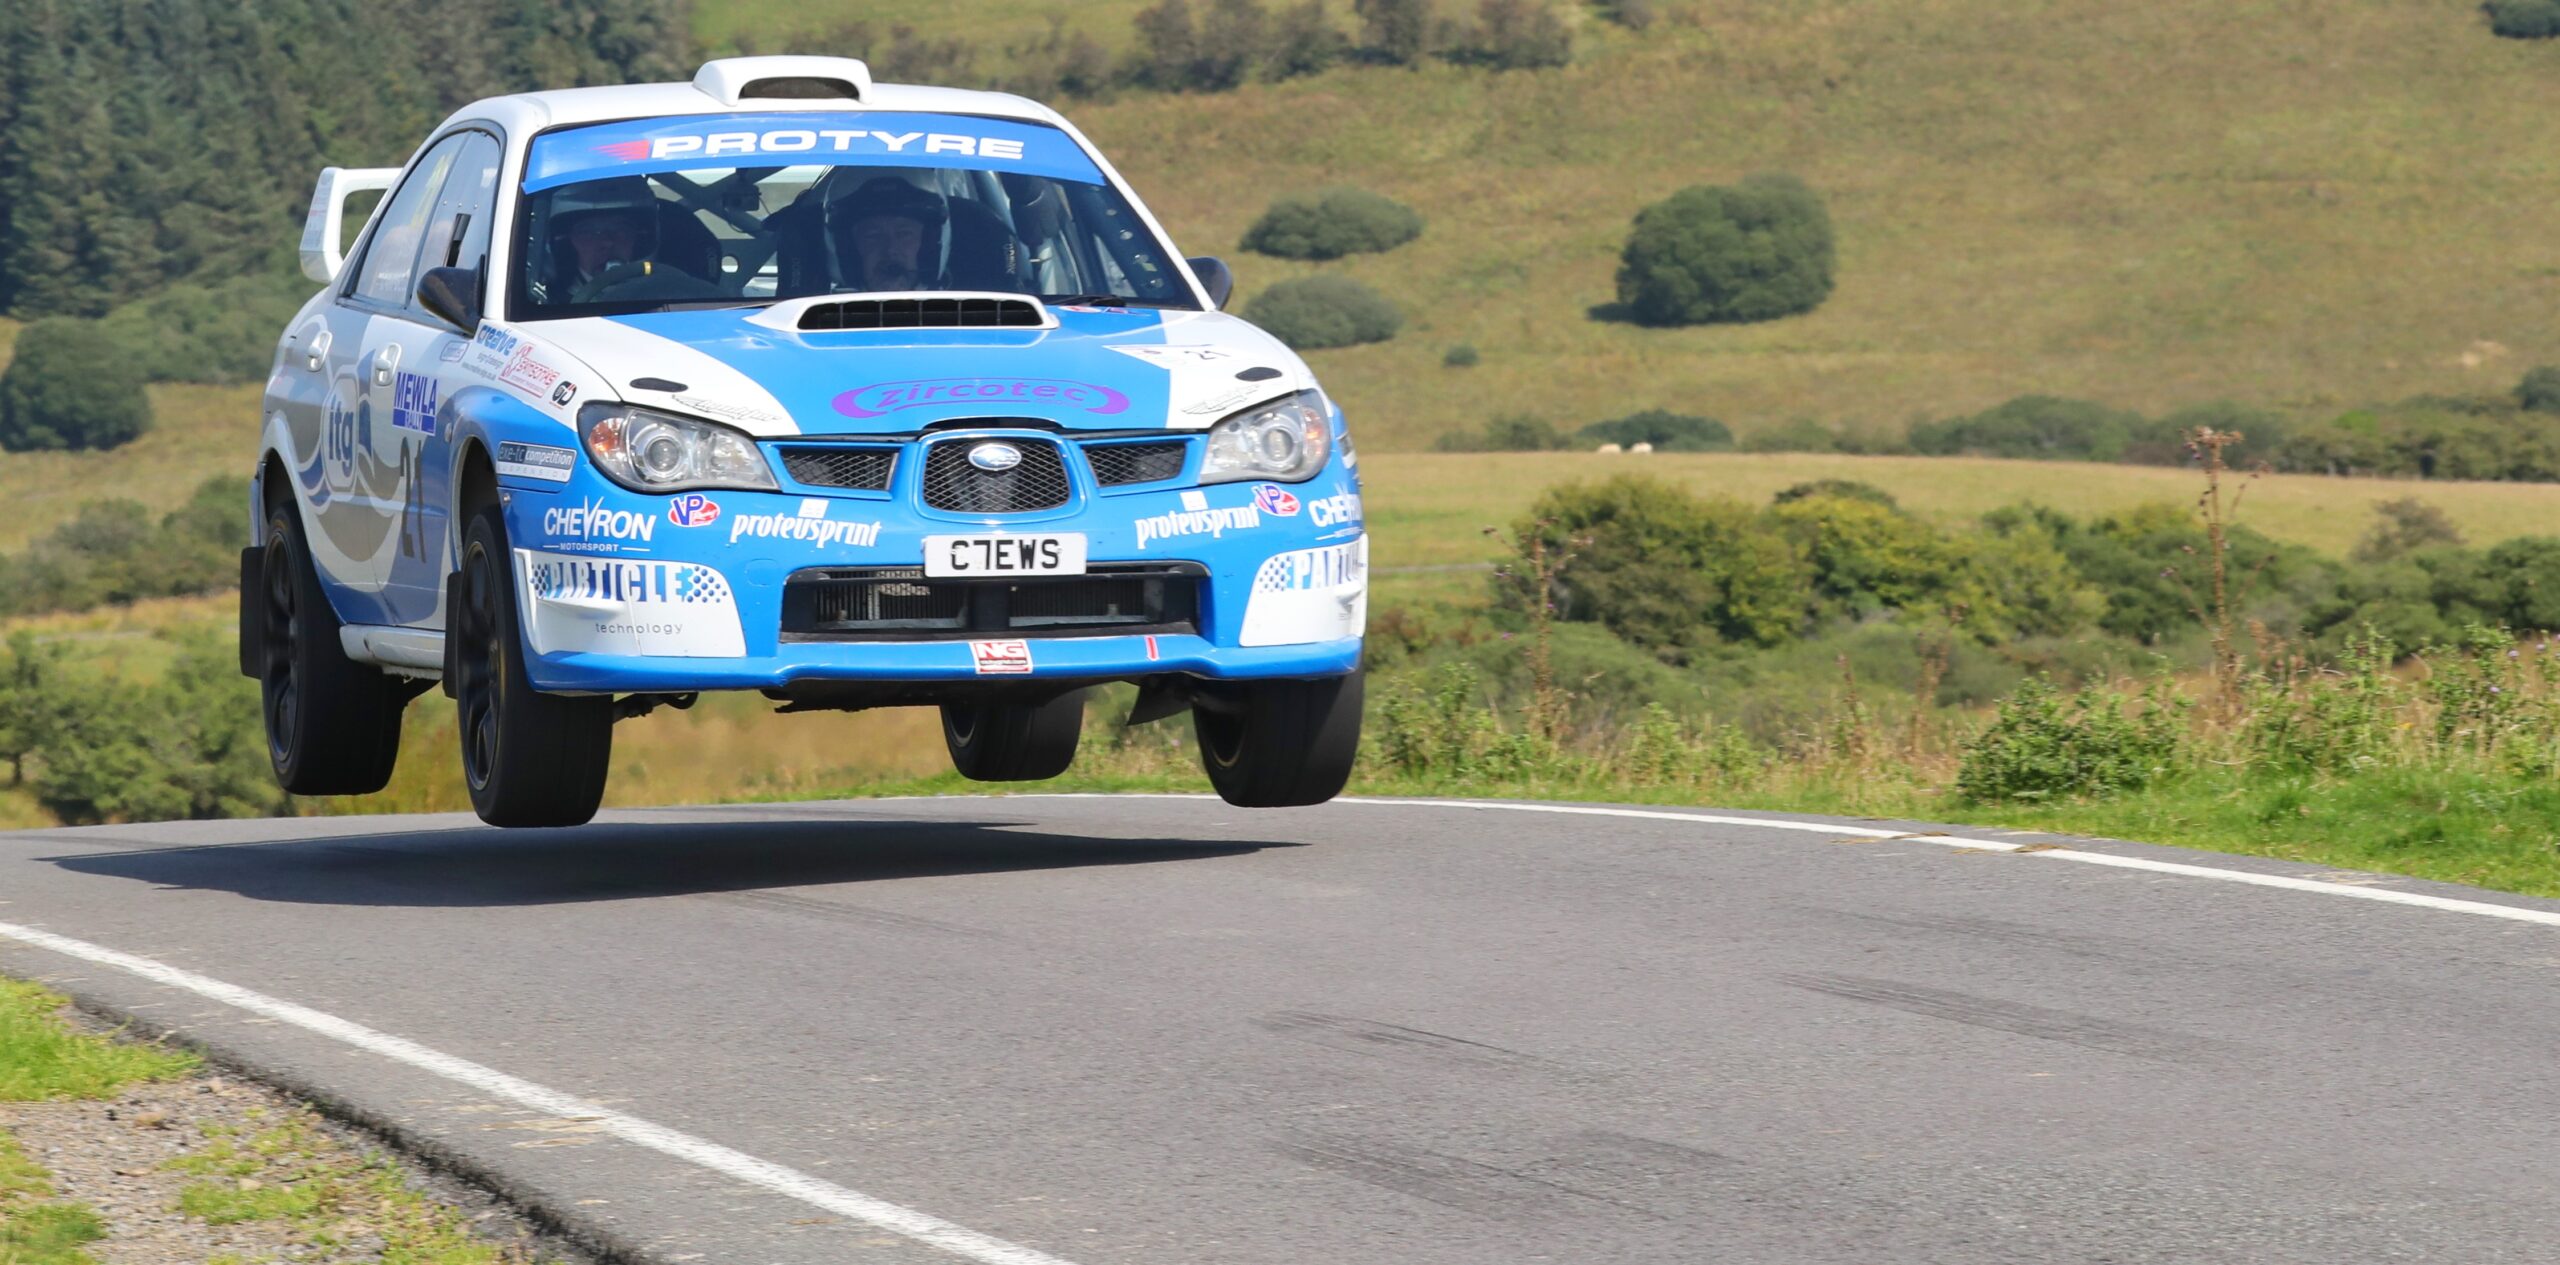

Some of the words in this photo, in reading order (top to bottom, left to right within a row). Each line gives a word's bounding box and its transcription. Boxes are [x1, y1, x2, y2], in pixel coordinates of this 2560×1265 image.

[651, 130, 1024, 160] PROTYRE
[394, 372, 437, 416] MEWLA
[876, 382, 1090, 408] zircotec
[329, 394, 354, 478] itg
[525, 449, 573, 466] competition
[400, 436, 427, 564] 21
[673, 495, 704, 525] VP
[1254, 485, 1281, 514] VP
[543, 496, 656, 542] CHEVRON
[730, 511, 882, 548] proteusprint
[1134, 502, 1260, 549] proteusprint
[560, 542, 619, 552] MOTORSPORT
[951, 538, 1060, 570] C7EWS
[547, 561, 690, 602] PARTICLE
[595, 621, 684, 635] technology
[976, 642, 1025, 658] NG
